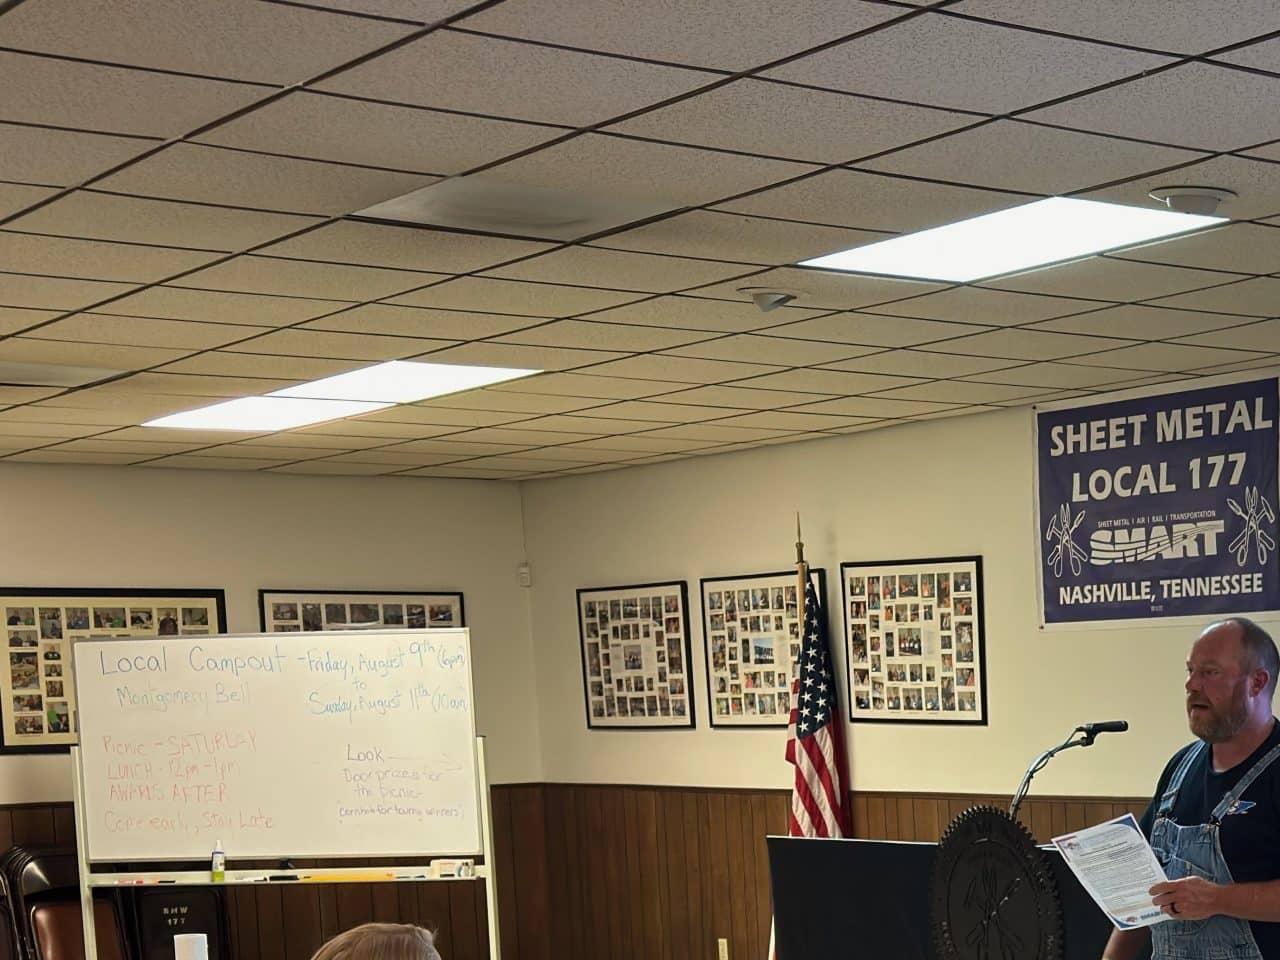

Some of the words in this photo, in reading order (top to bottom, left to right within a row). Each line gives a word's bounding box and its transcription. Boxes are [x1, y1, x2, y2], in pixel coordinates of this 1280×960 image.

[1050, 413, 1148, 457] SHEET
[1155, 397, 1273, 443] METAL
[1071, 462, 1177, 502] LOCAL
[1188, 452, 1247, 490] 177
[1097, 519, 1113, 529] SHEET
[1113, 518, 1130, 528] METAL
[1136, 516, 1146, 525] AIR
[1151, 514, 1164, 523] RAIL
[1169, 509, 1217, 521] TRANSPORTATION
[1089, 519, 1225, 567] SMART
[1058, 581, 1157, 605] NASHVILLE,
[1159, 573, 1264, 600] TENNESSEE
[99, 646, 168, 676] Local
[188, 645, 288, 683] Campout
[357, 649, 405, 681] August
[215, 682, 251, 705] Bell
[351, 677, 367, 691] to
[346, 743, 385, 764] Look
